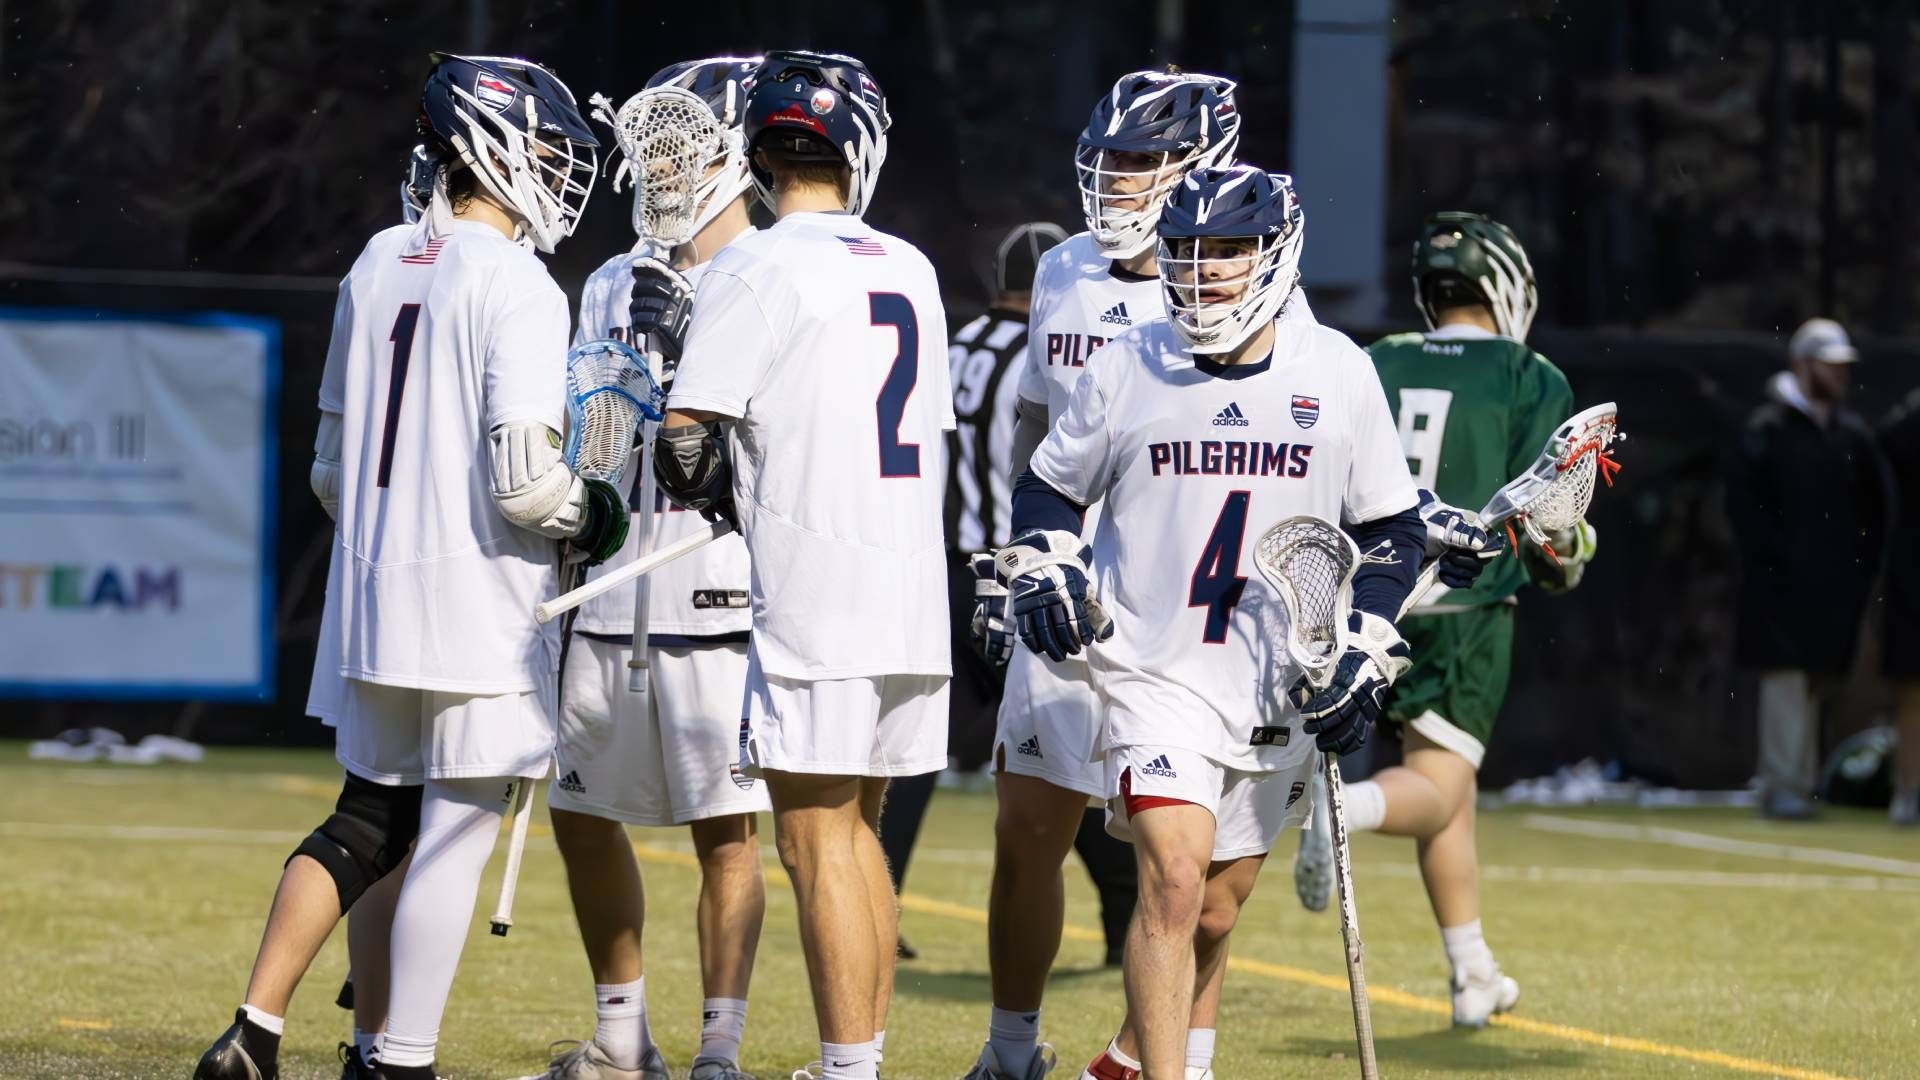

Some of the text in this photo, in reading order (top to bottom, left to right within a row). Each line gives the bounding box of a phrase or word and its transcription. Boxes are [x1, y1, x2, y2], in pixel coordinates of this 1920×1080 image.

[1047, 333, 1114, 368] PIL
[376, 303, 422, 488] 1
[867, 291, 921, 479] 2
[1212, 416, 1249, 427] adidas
[1147, 440, 1314, 479] PILGRIMS
[0, 562, 182, 611] TEAM
[1188, 490, 1251, 644] 4
